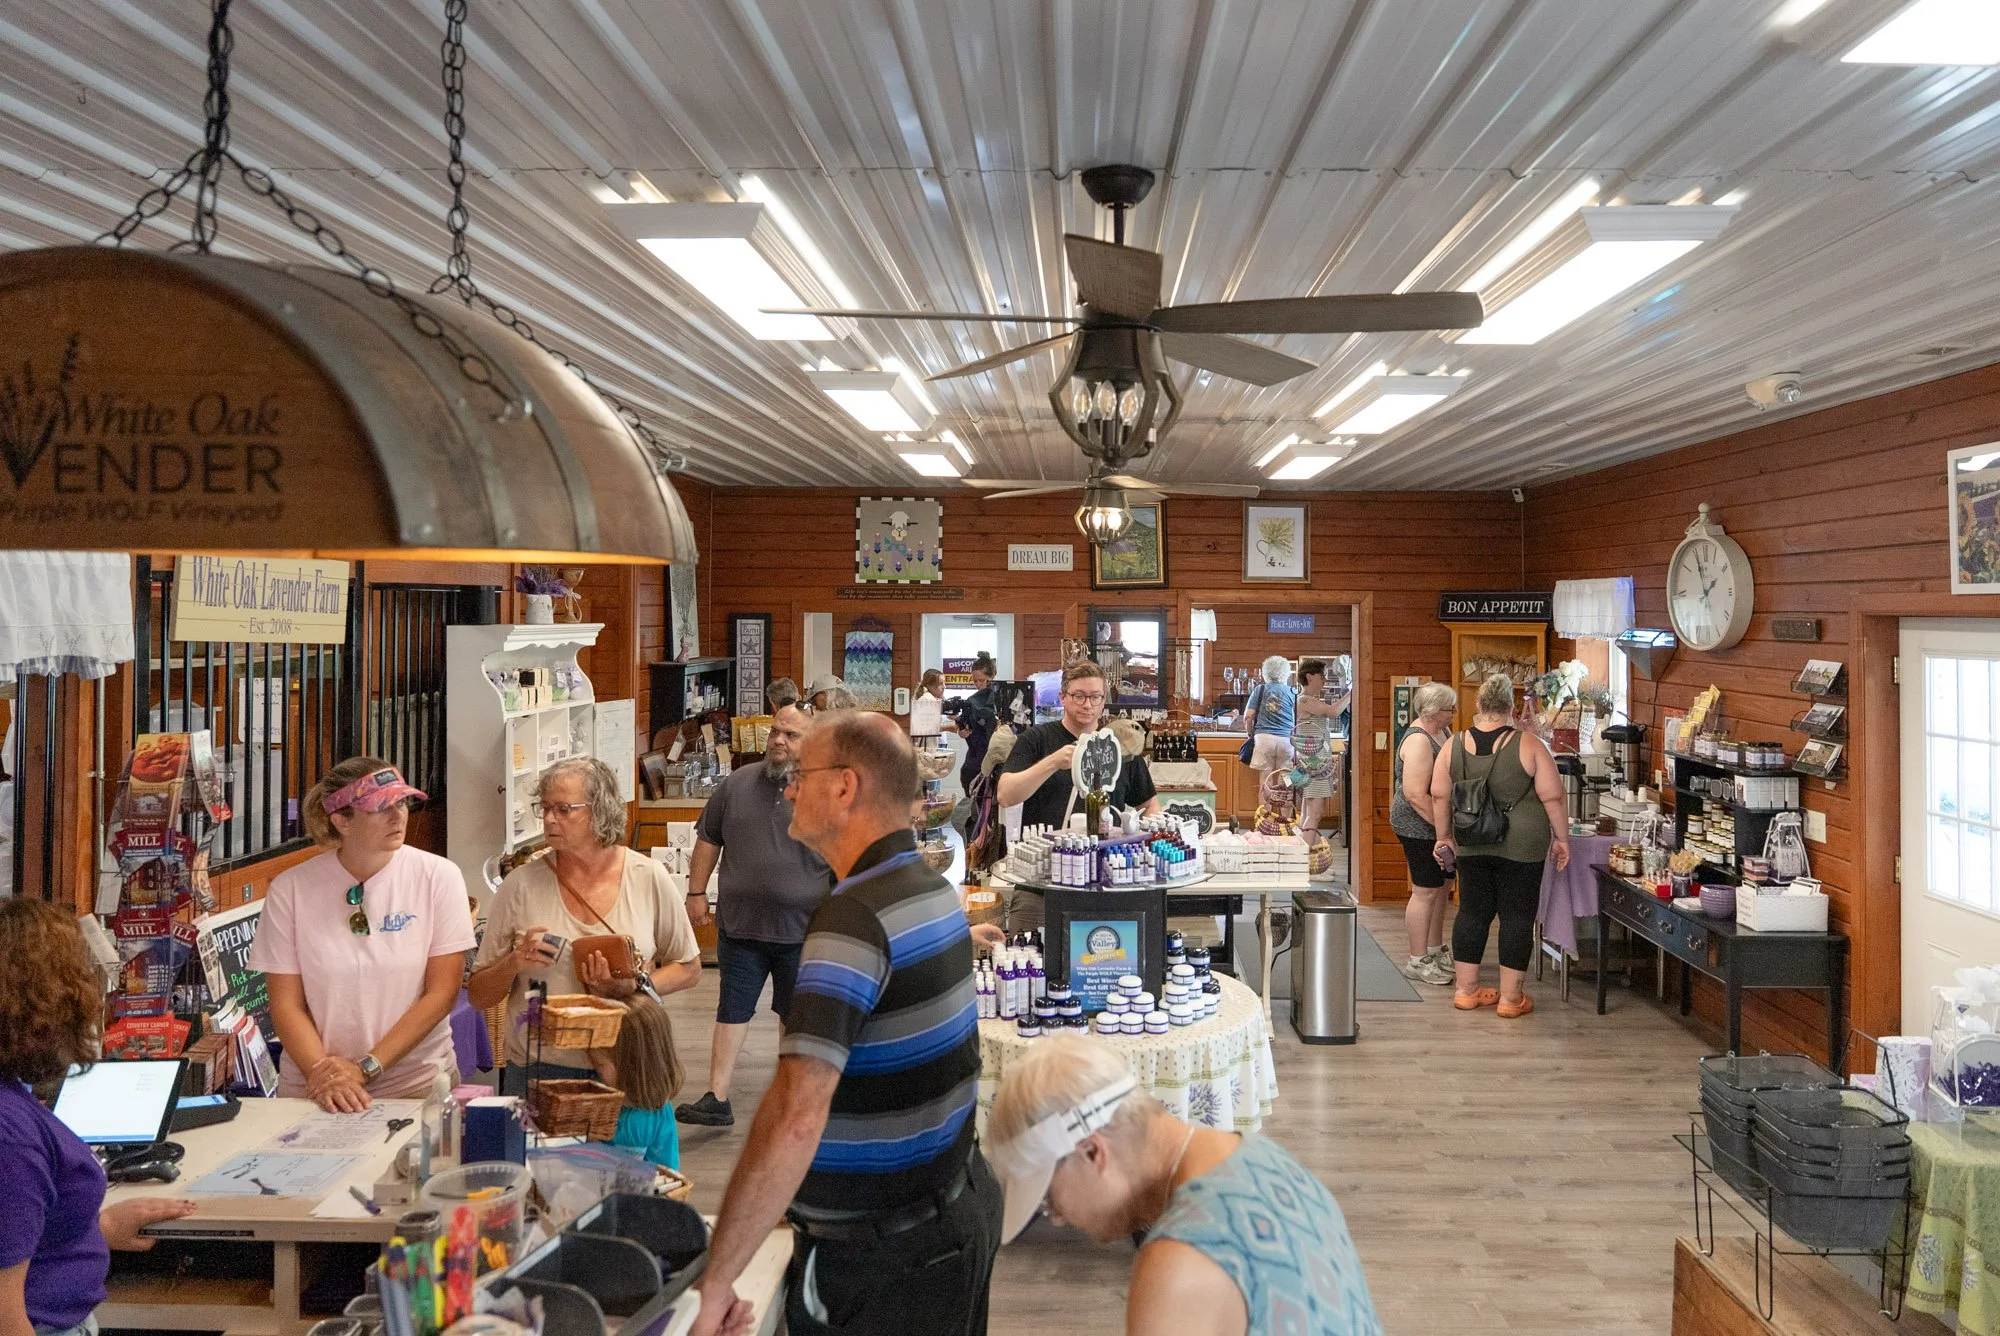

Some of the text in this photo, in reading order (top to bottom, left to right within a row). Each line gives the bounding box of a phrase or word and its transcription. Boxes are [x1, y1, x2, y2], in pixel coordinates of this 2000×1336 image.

[52, 389, 281, 437] White Oak
[85, 499, 166, 522] WOLF
[170, 500, 285, 525] Vineyard
[1012, 550, 1069, 564] DREAM BIG
[193, 555, 340, 614] White Oak Lavender Farm
[1447, 601, 1544, 614] BON APPETIT
[269, 618, 293, 635] 2008
[948, 661, 974, 669] DISCO
[945, 675, 973, 683] ENTRA
[128, 836, 160, 847] MILL
[123, 925, 157, 936] MILL
[172, 925, 192, 941] ILL
[213, 918, 259, 953] APPENIN
[1091, 940, 1116, 949] Valley
[230, 971, 248, 988] Pick
